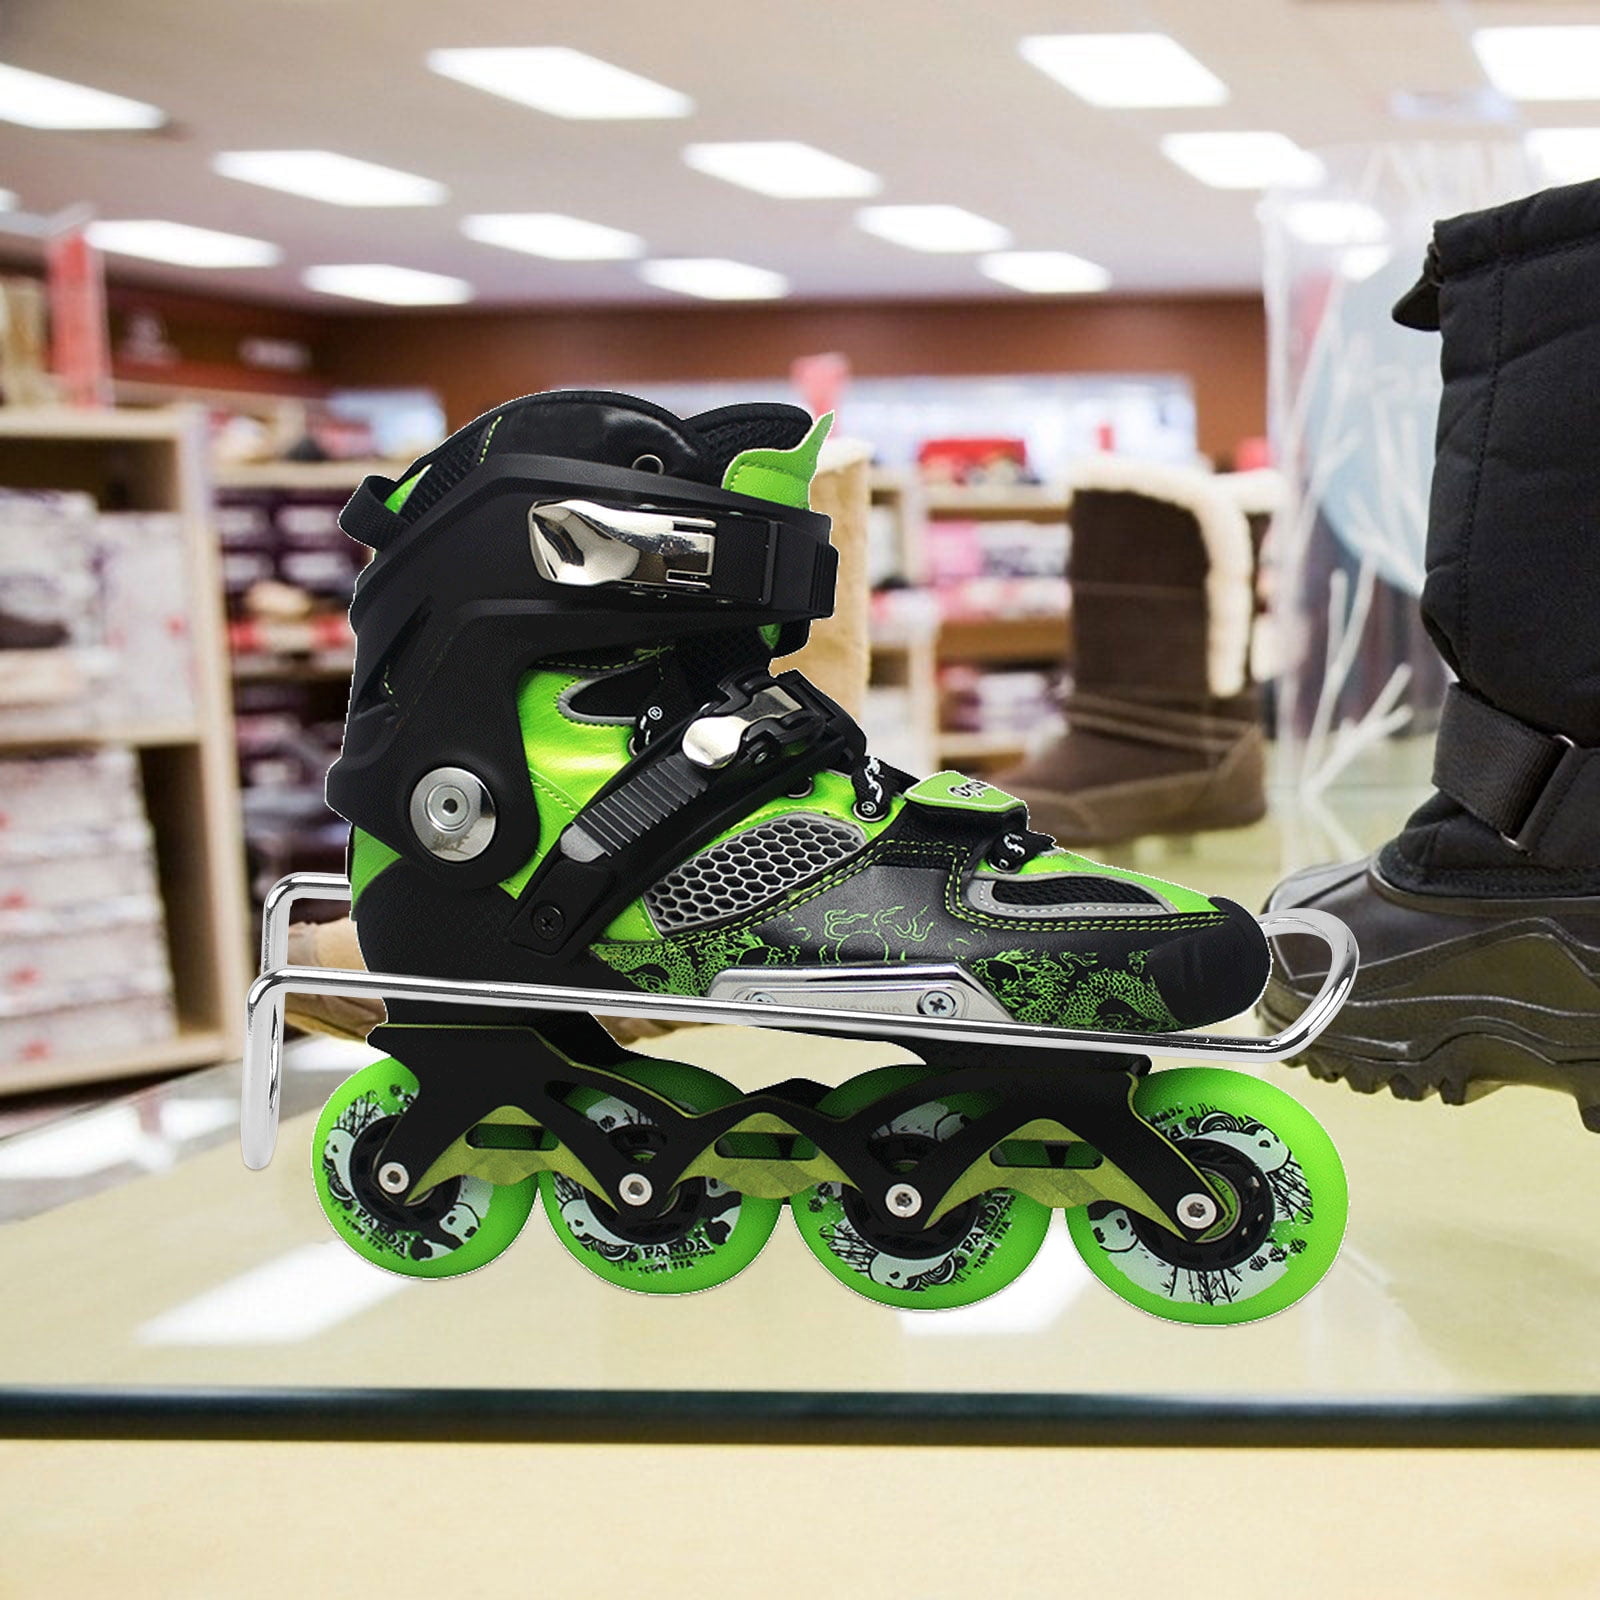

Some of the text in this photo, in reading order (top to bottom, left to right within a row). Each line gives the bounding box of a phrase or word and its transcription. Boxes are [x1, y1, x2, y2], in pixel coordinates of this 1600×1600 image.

[355, 1208, 407, 1259] PANDA
[643, 1239, 711, 1259] PANDA
[961, 1194, 1010, 1254] PANDA
